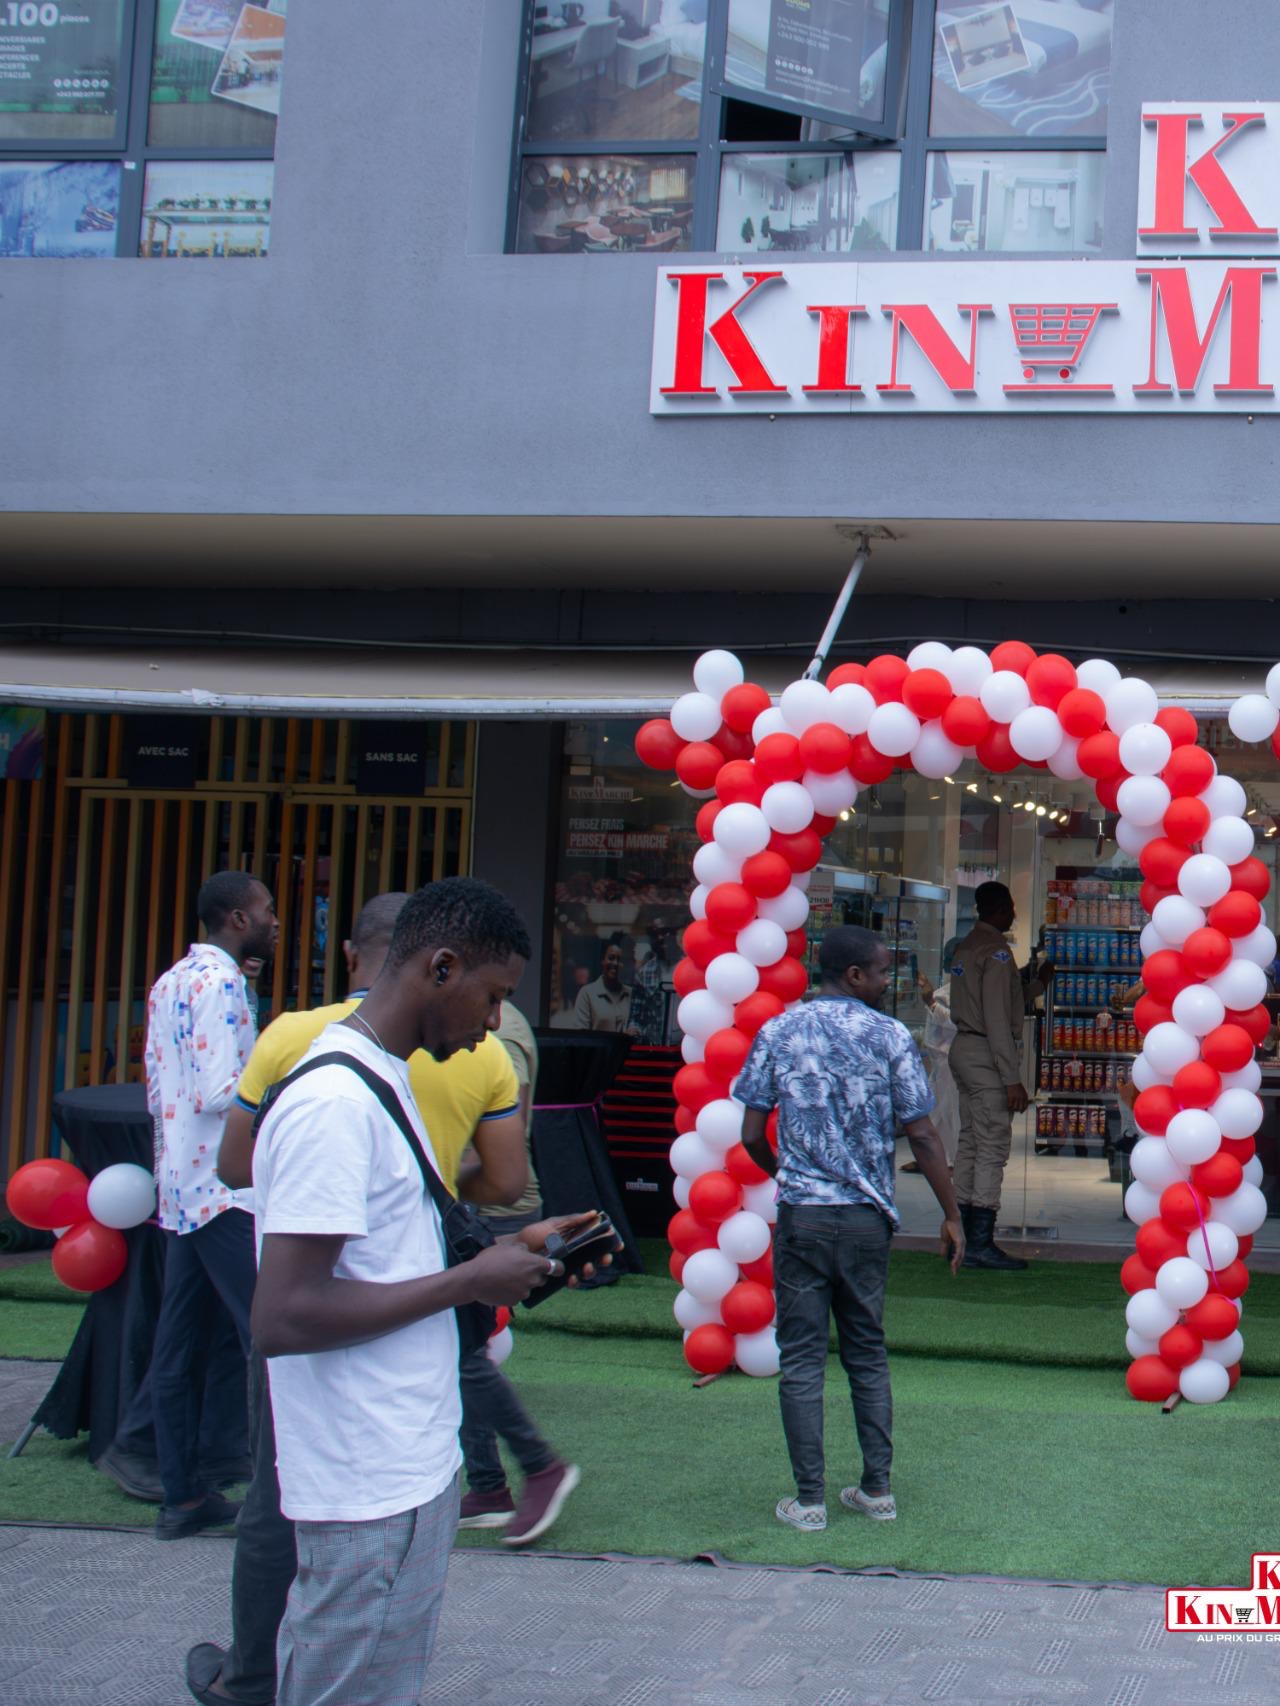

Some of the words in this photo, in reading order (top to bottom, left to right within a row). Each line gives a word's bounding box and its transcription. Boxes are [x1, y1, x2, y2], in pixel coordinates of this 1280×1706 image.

[1139, 112, 1280, 240] K
[659, 271, 996, 400] KIN
[138, 746, 166, 756] AVEC
[168, 747, 189, 757] SAC
[365, 752, 394, 762] SANS
[396, 753, 418, 763] SAC
[569, 833, 606, 848] PENSEZ
[608, 833, 624, 848] KIN
[626, 834, 669, 848] MARCHE
